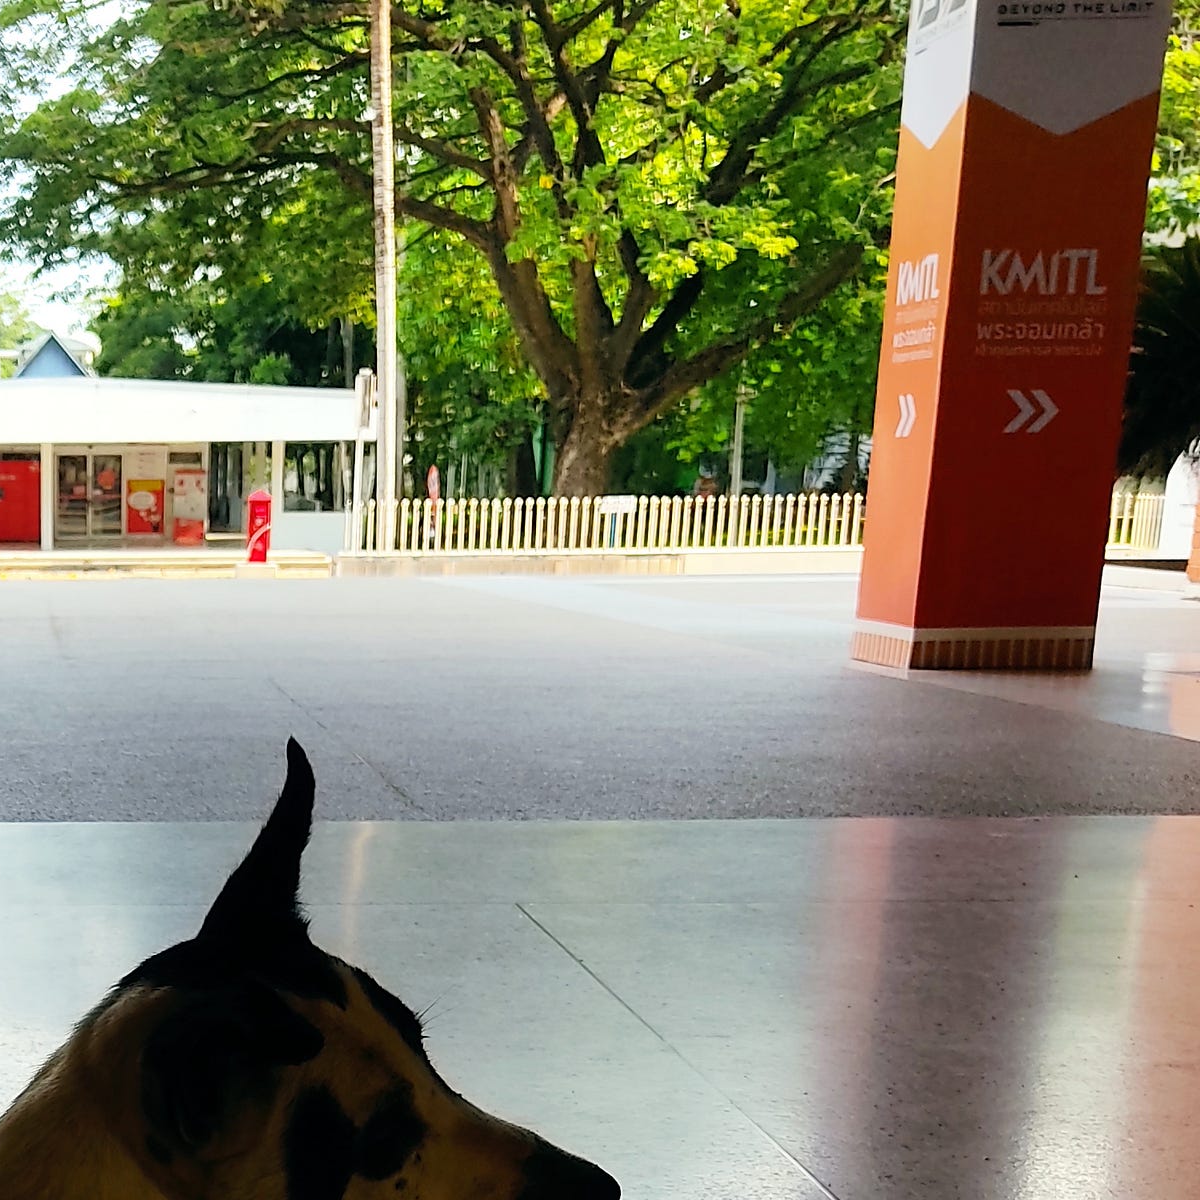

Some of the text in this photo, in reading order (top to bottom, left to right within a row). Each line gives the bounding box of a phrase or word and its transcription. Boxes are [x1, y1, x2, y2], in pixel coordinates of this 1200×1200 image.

[997, 2, 1156, 14] BEYOND THE LIMIT
[979, 248, 1107, 295] KMITL
[976, 317, 1105, 340] พระจอมเกล้า
